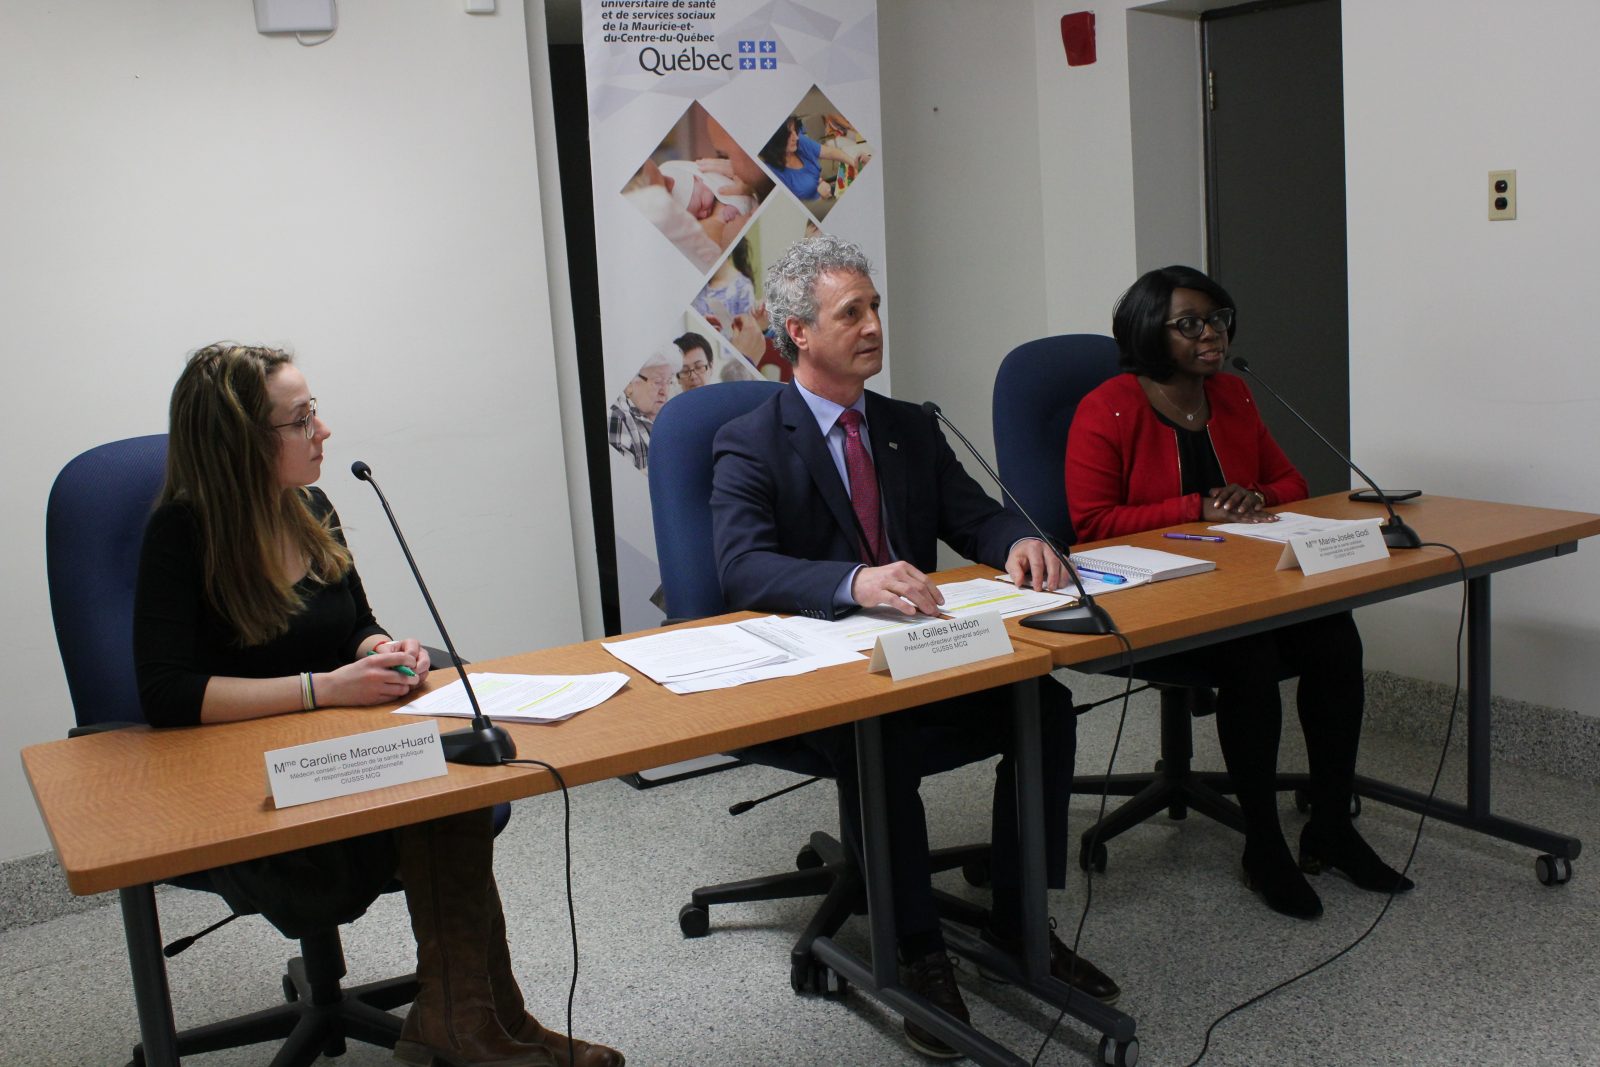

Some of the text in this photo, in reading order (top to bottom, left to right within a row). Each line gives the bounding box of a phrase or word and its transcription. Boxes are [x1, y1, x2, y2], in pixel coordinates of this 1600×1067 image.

[601, 0, 716, 8] universitaire de santé
[602, 10, 716, 20] et de services sociaux
[602, 21, 694, 31] de la Mauricie-et-
[603, 32, 715, 43] du-Centre-du-Québec
[639, 46, 734, 76] Québec
[908, 619, 979, 642] M. Gilles Hudon
[274, 733, 435, 774] Mme Caroline Marcoux-Huard
[290, 770, 315, 780] Médecin
[316, 766, 337, 775] conseil
[342, 759, 368, 771] Direction
[400, 749, 424, 760] publique
[340, 772, 381, 785] CIUSSS MCQ
